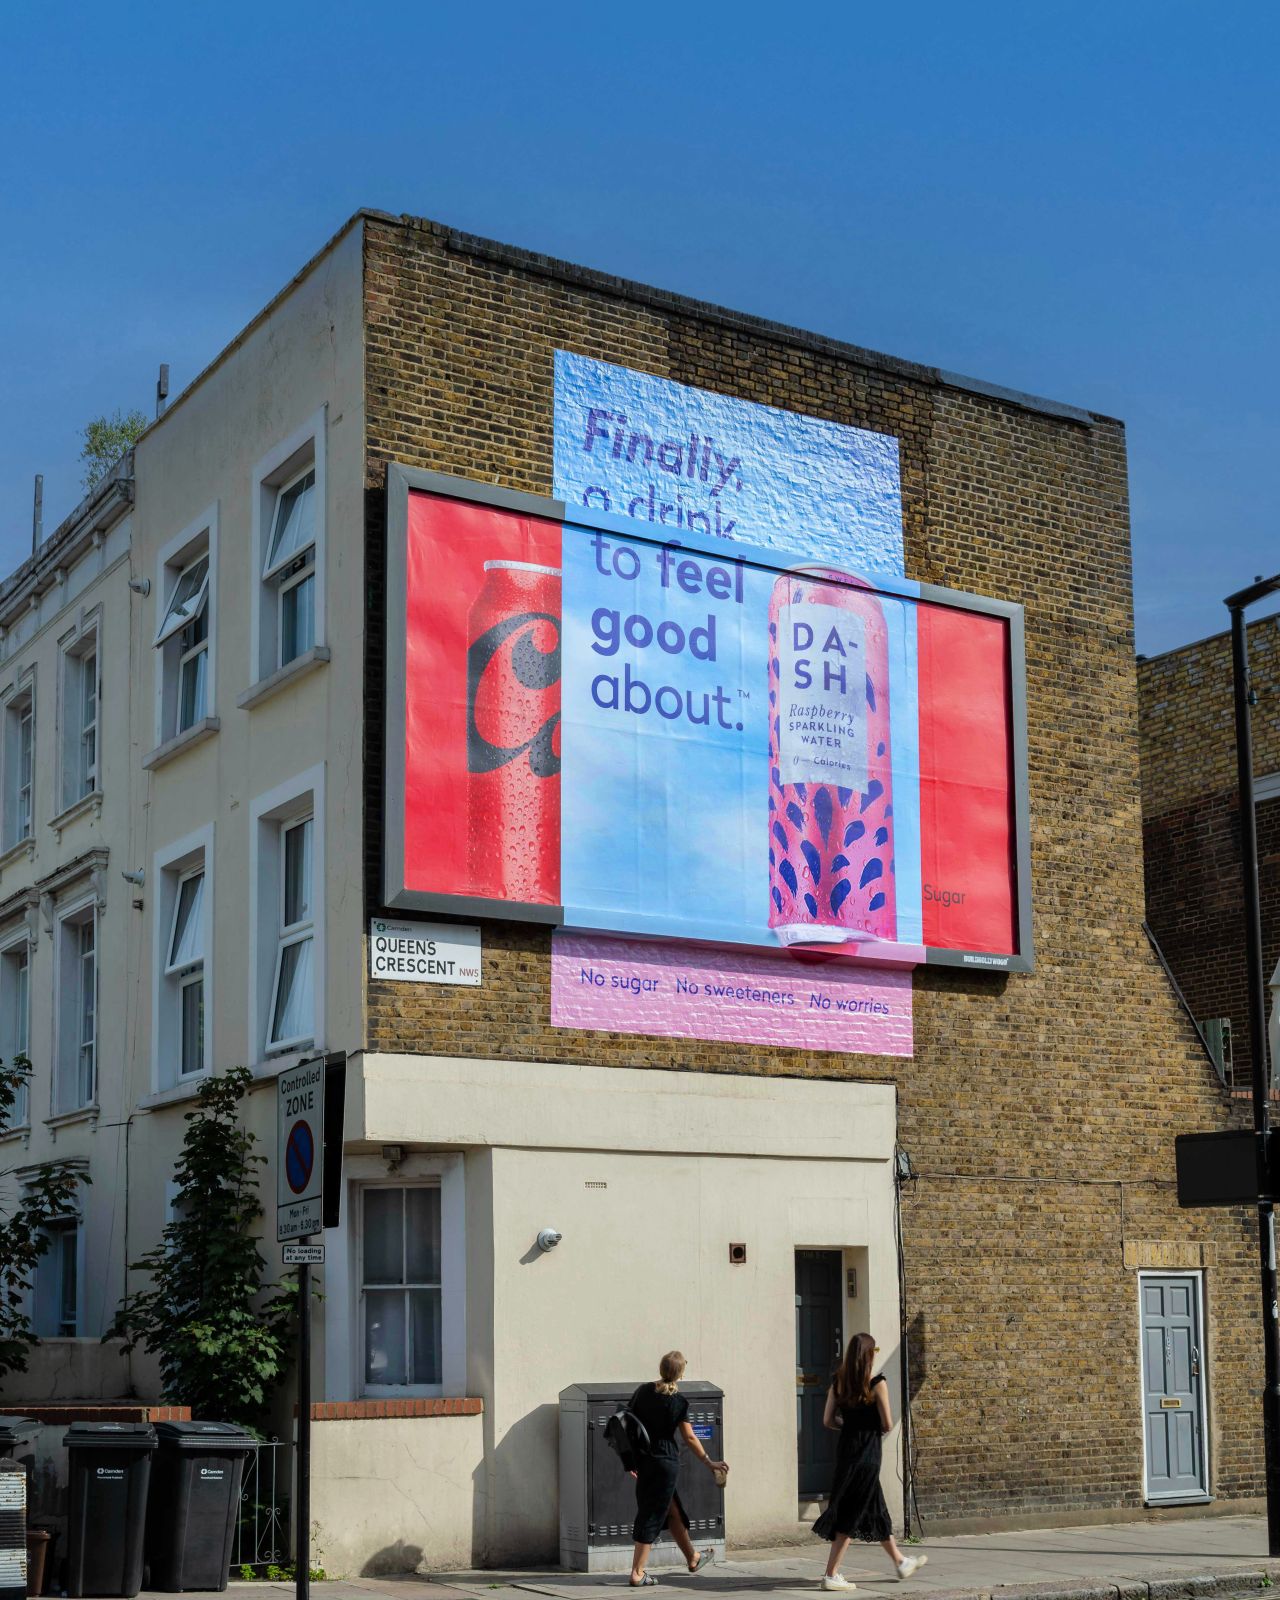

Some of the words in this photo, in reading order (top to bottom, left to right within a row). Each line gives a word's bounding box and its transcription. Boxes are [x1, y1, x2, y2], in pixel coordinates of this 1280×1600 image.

[590, 529, 641, 580] to
[656, 539, 747, 603] feel
[591, 607, 716, 662] good
[591, 663, 744, 731] about.
[789, 703, 854, 725] Raspberry
[789, 721, 855, 738] SPARKLING
[801, 735, 842, 749] WATER
[813, 756, 851, 770] Calories
[924, 884, 966, 907] Sugar
[376, 956, 455, 976] CRESCENT
[581, 968, 605, 986] No
[611, 975, 659, 995] sugar
[676, 977, 699, 995] No
[704, 984, 795, 1006] sweeteners
[810, 992, 831, 1010] No
[836, 997, 889, 1015] worries
[281, 1067, 320, 1095] Controlled
[286, 1091, 314, 1117] ZONE
[298, 1247, 321, 1255] loading
